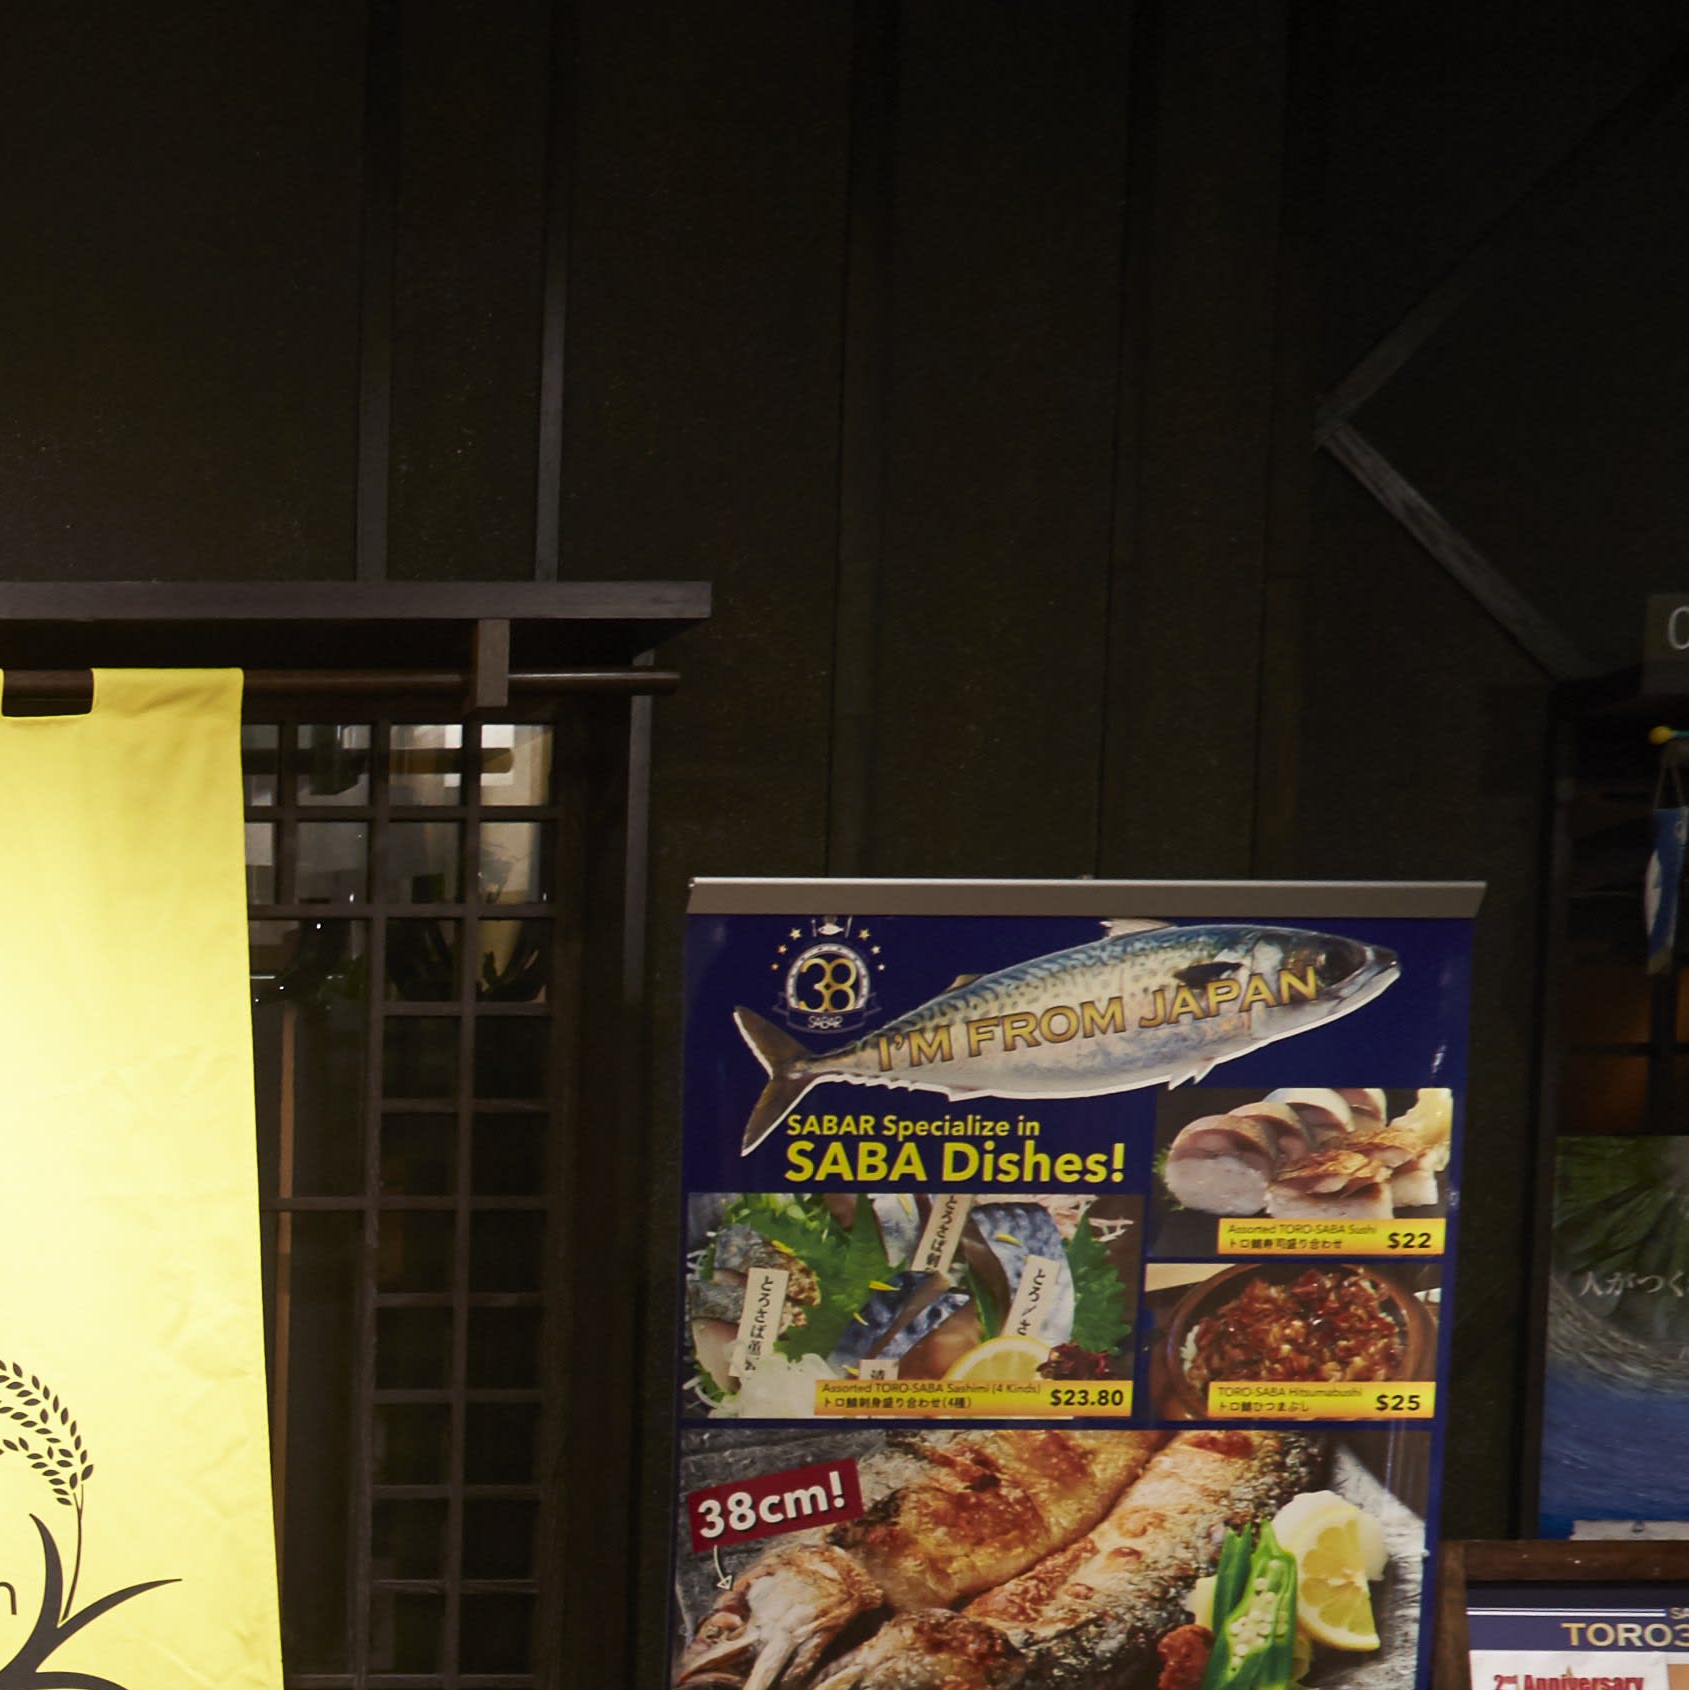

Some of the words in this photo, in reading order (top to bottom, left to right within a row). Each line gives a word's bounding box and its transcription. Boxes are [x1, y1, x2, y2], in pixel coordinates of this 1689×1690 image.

[878, 1023, 955, 1073] I'M
[965, 996, 1127, 1058] FROM
[1138, 965, 1319, 1029] JAPAN
[786, 1115, 876, 1136] SABAR
[882, 1114, 1011, 1142] Specialize
[1017, 1114, 1040, 1136] in
[784, 1140, 928, 1183] SABA
[941, 1139, 1126, 1183] Dishes!
[1386, 1231, 1432, 1250] $22
[821, 1382, 872, 1394] Assorted
[874, 1382, 944, 1394] TORO-SABA
[946, 1382, 991, 1394] Sashimi
[1049, 1388, 1125, 1407] $23.80
[1375, 1393, 1421, 1412] $25
[697, 1470, 846, 1539] 38cm!
